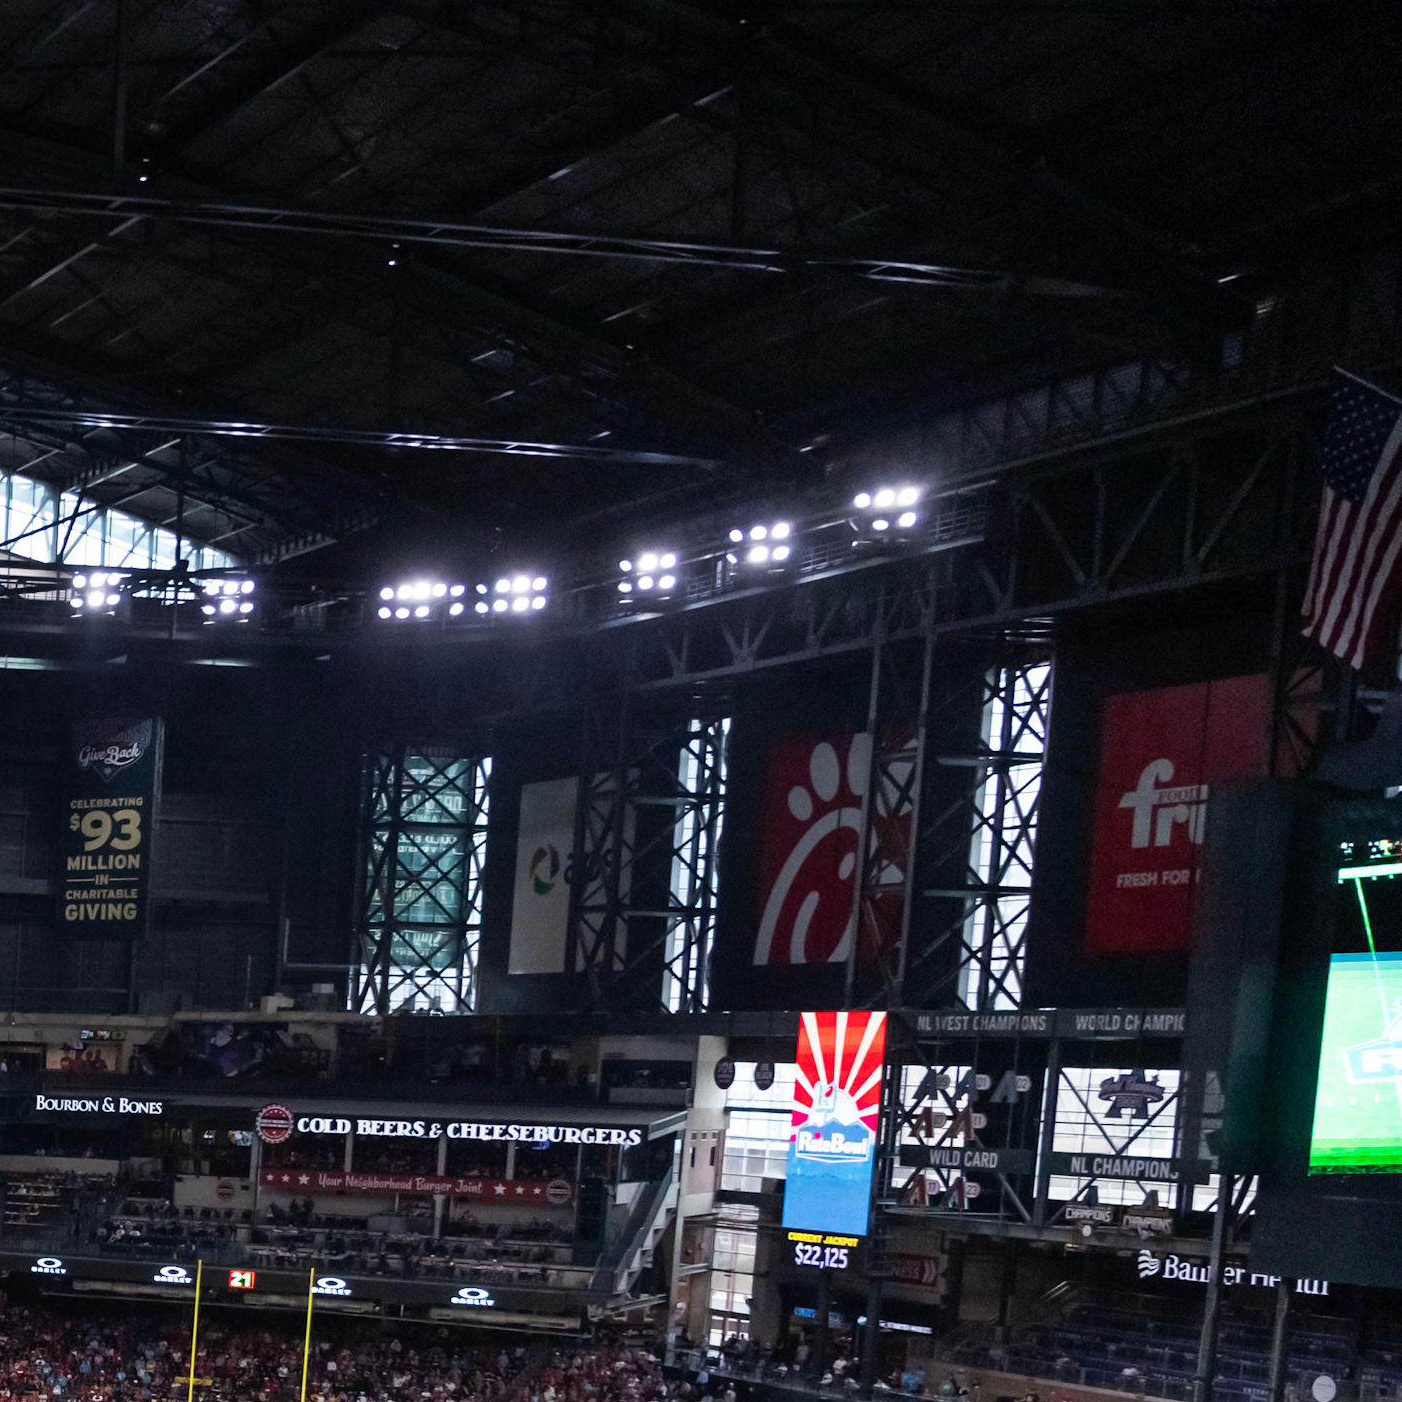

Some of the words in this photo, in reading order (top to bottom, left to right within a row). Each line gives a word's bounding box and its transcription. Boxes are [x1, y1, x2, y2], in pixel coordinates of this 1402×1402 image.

[79, 746, 106, 768] Give
[104, 742, 141, 766] Back
[70, 796, 143, 809] CELEBRATING
[69, 808, 142, 852] $93
[67, 854, 141, 871] MILLION
[95, 874, 109, 885] IN
[1116, 870, 1158, 888] FRESH
[1161, 869, 1191, 885] FOR
[65, 888, 138, 900] CHARITABLE
[65, 903, 137, 921] GIVING
[917, 1015, 932, 1031] NL
[972, 1015, 1047, 1033] CHAMPIONS
[1075, 1015, 1120, 1031] WORLD
[36, 1094, 99, 1113] BOURBON
[101, 1096, 116, 1114] &
[119, 1097, 163, 1115] BONES
[297, 1115, 352, 1136] COLD
[356, 1118, 425, 1139] BEERS
[430, 1121, 443, 1139] &
[446, 1121, 642, 1147] CHEESEBURGERS
[929, 1150, 961, 1166] WILD
[963, 1151, 999, 1169] CARD
[1070, 1156, 1090, 1174] NL
[318, 1173, 343, 1190] Your
[345, 1173, 412, 1193] Neighborhood
[414, 1176, 454, 1195] Burger
[456, 1177, 483, 1194] Joint
[966, 1184, 977, 1195] 23
[794, 1244, 849, 1268] $22,125
[231, 1271, 254, 1289] 21
